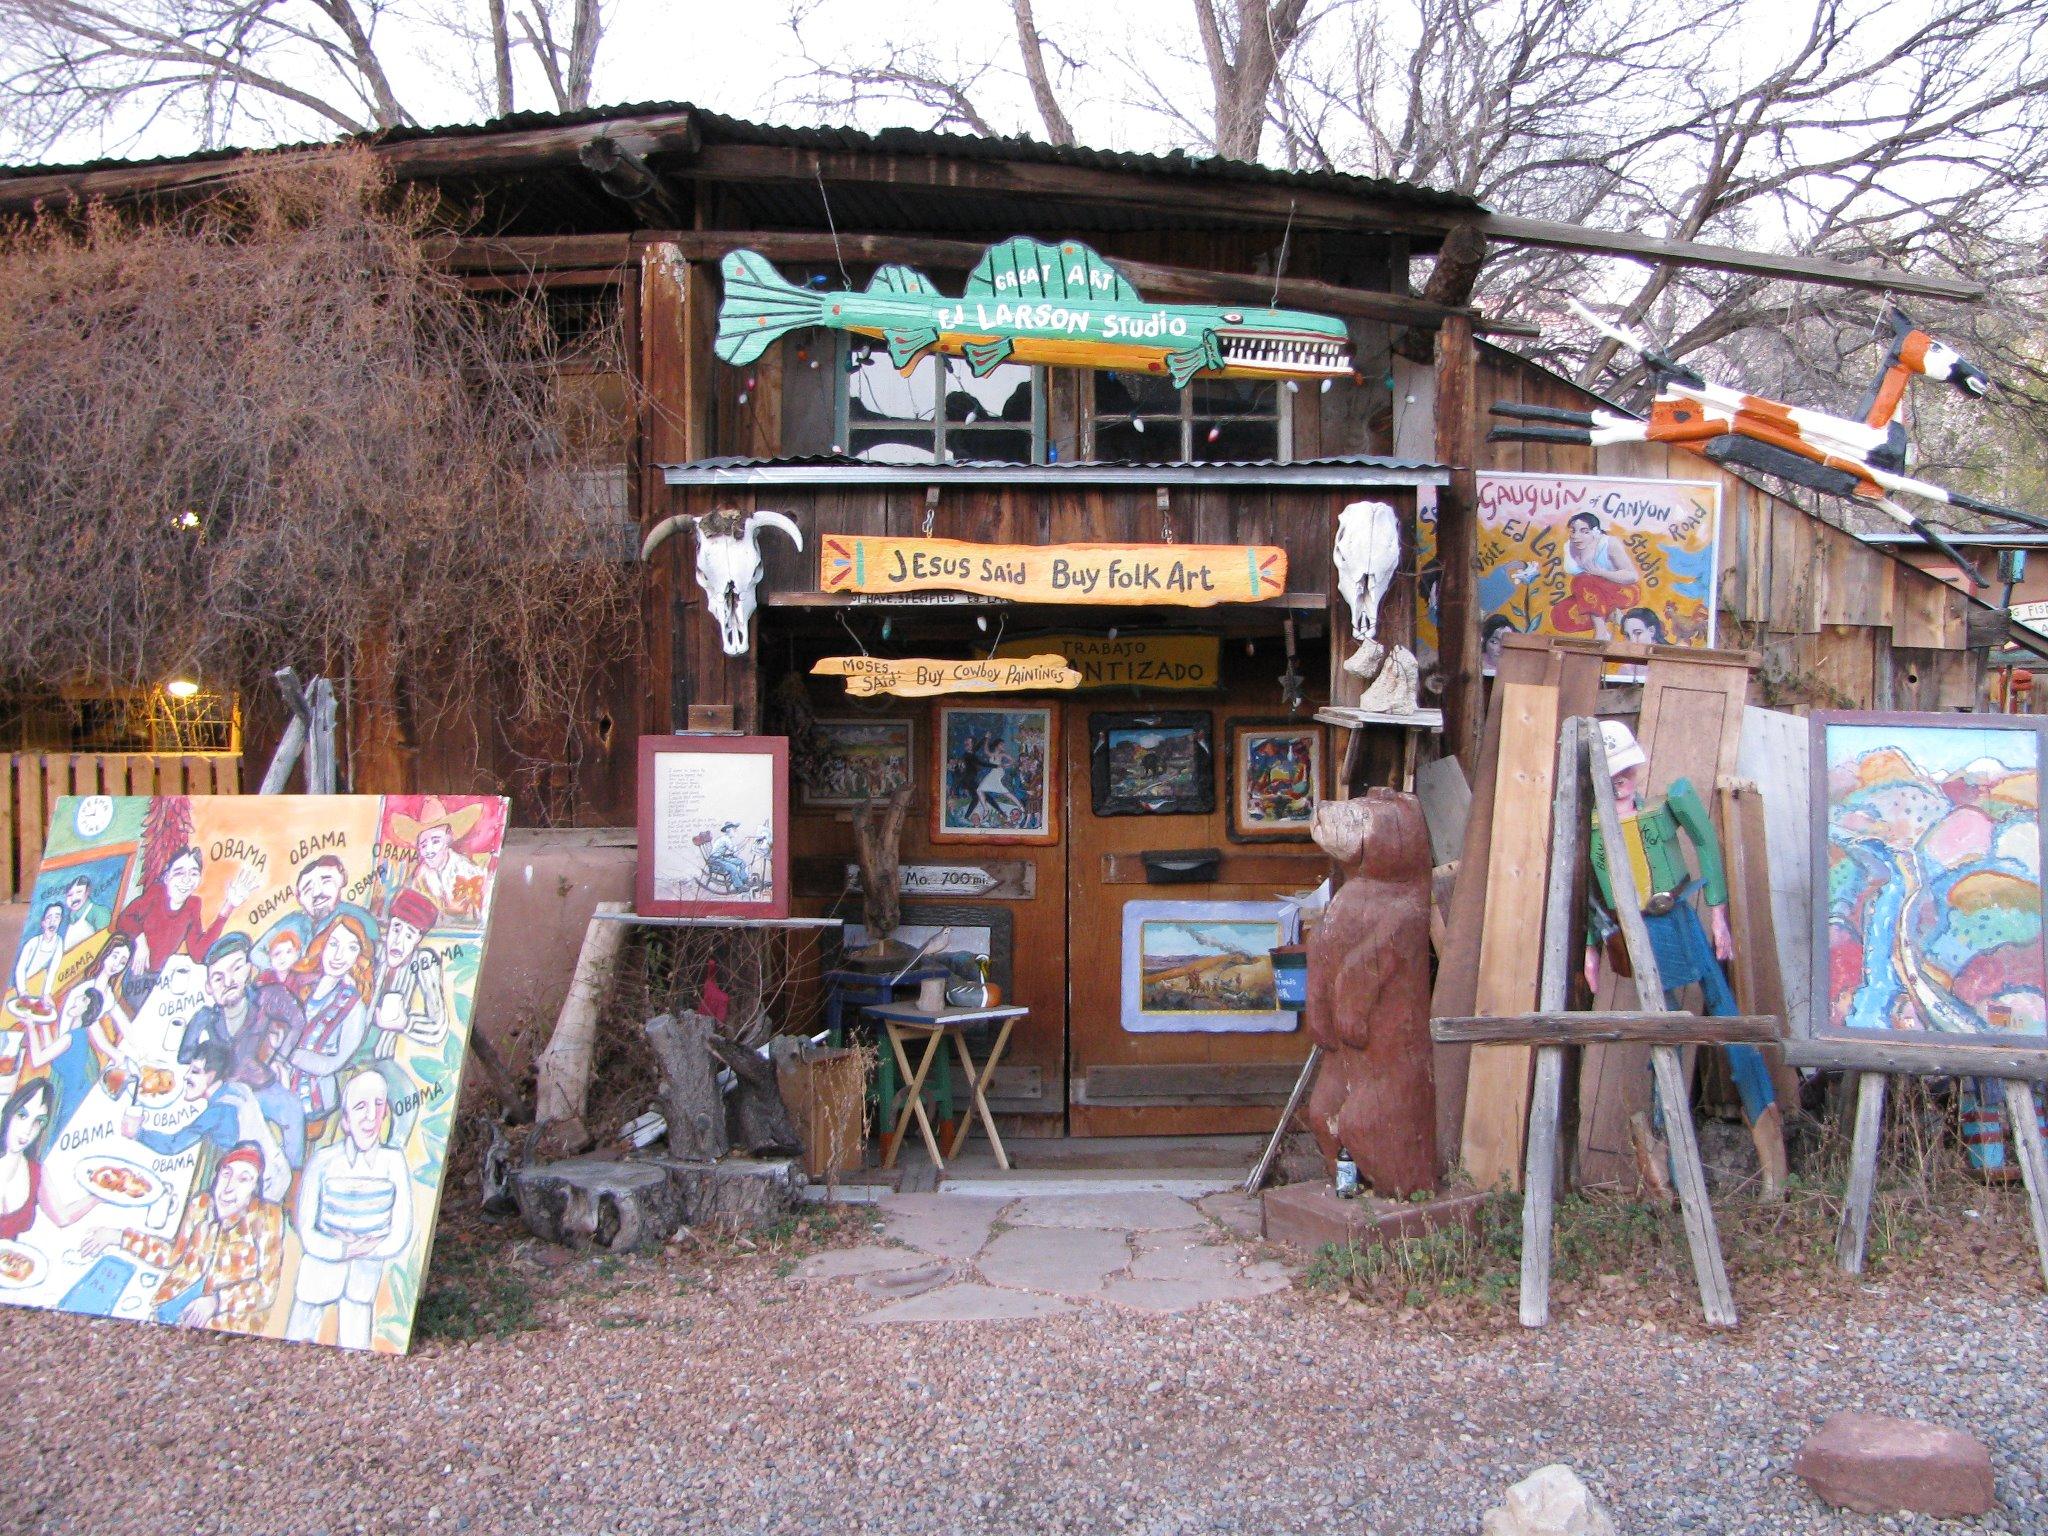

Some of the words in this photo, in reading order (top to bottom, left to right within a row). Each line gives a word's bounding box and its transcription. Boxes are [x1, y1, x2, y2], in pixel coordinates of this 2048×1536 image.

[995, 264, 1051, 291] GREAT
[1067, 265, 1113, 291] ART
[976, 304, 1090, 334] LARSON
[1501, 518, 1531, 543] Ed
[1623, 533, 1660, 588] Studio
[1052, 559, 1100, 593] Buy
[1166, 560, 1215, 592] Art
[1062, 640, 1146, 657] TRABAJO
[916, 666, 944, 687] Buy
[1068, 660, 1203, 681] NTIZADO
[210, 838, 267, 873] OBAMA
[290, 830, 346, 865] OBAMA
[372, 843, 420, 862] OBAMA
[346, 865, 387, 902] OBAMA
[906, 872, 930, 885] Mo.
[941, 872, 970, 885] 700
[248, 884, 295, 925] OBAMA
[57, 952, 95, 982] OBAMA
[410, 944, 464, 975] OBAMA
[125, 976, 170, 996] OBAMA
[159, 991, 205, 1017] OBAMA
[395, 1081, 444, 1116] OBAMA
[153, 1104, 199, 1127] OBAMA
[60, 1120, 114, 1151] OBAMA
[152, 1153, 195, 1173] OBAMA
